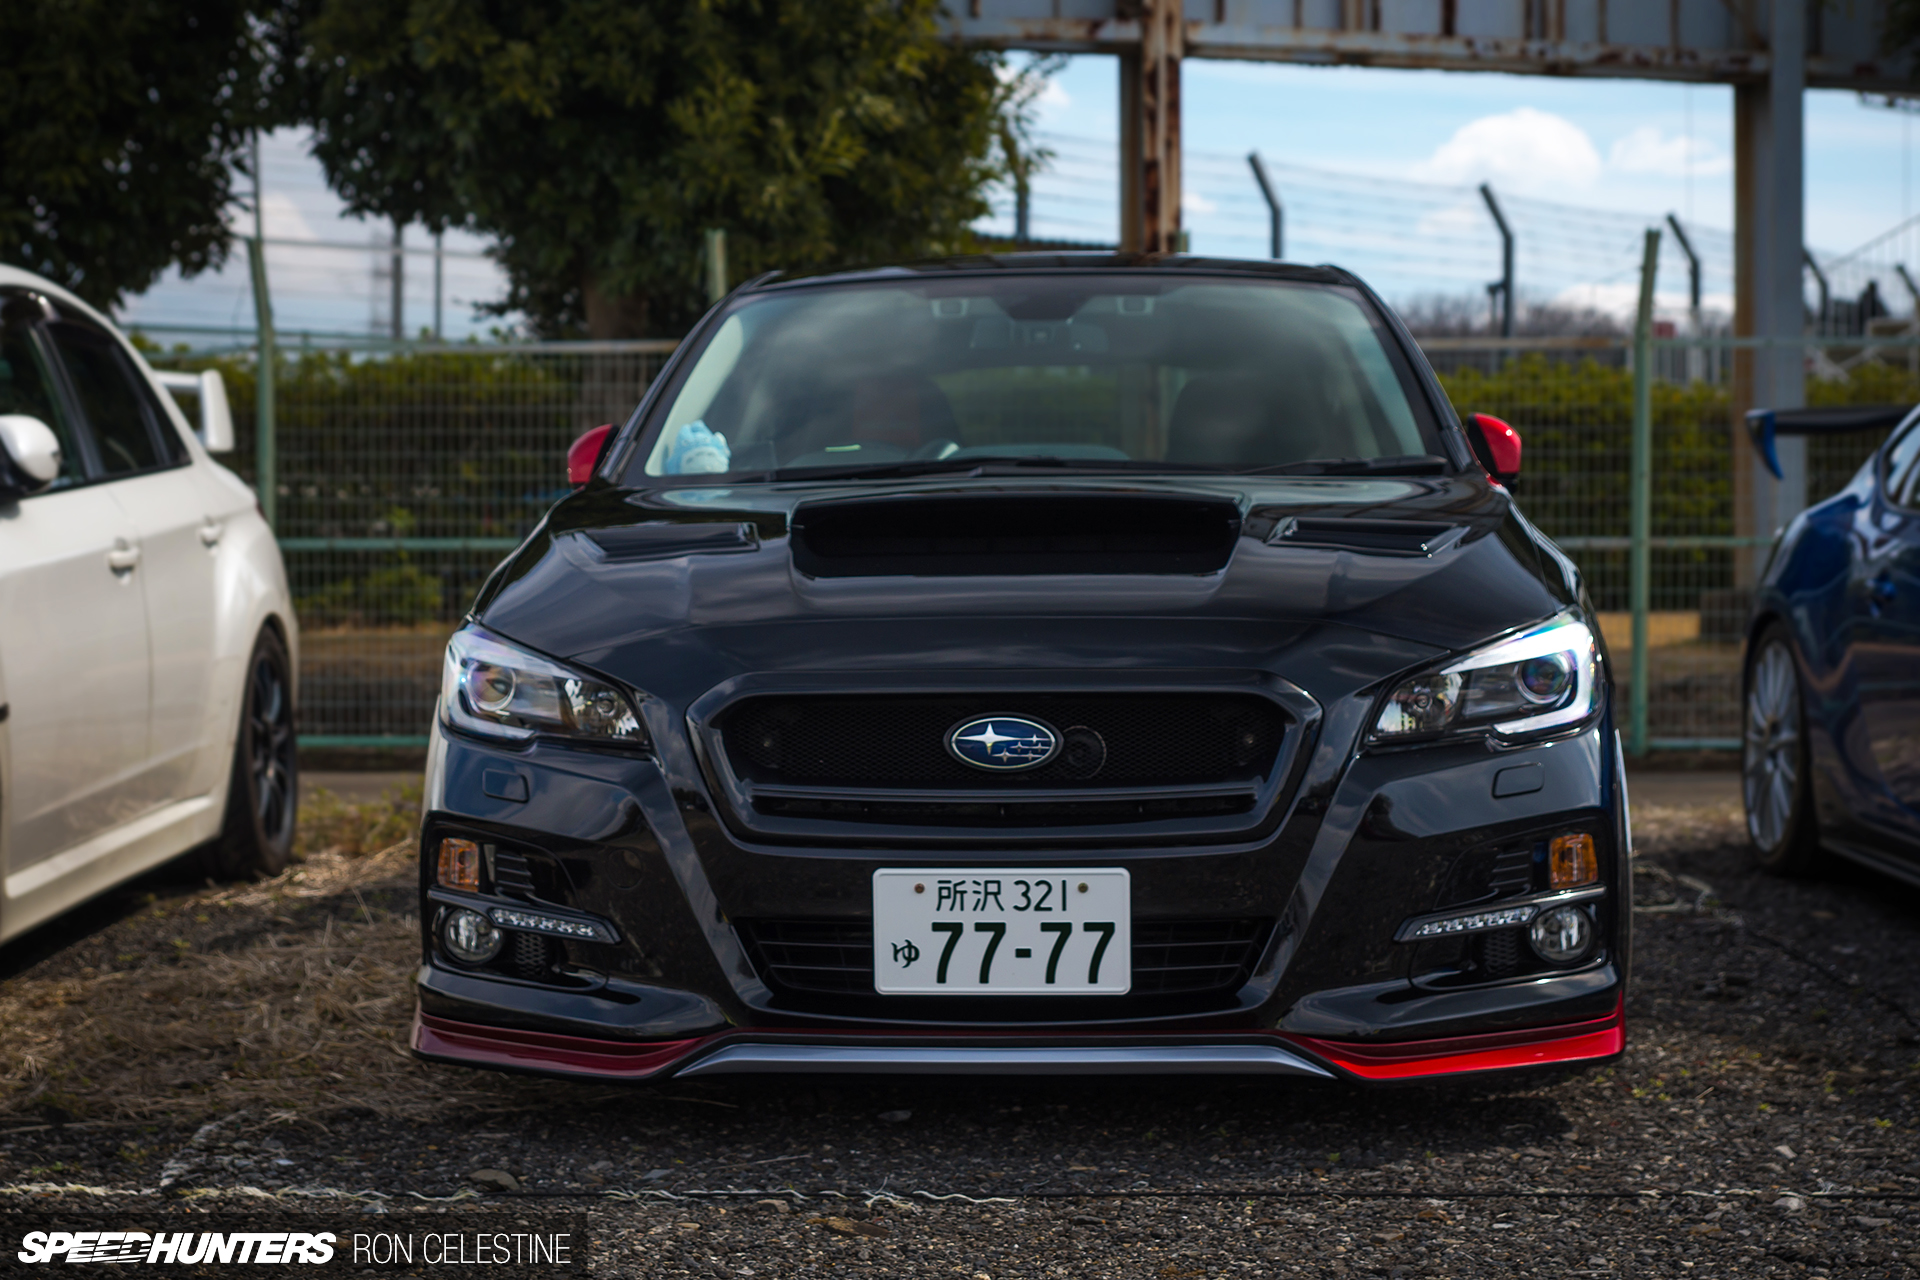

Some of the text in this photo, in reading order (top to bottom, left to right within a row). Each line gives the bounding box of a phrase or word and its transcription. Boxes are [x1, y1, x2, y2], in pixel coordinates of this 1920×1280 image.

[936, 879, 1067, 912] 所沢 321
[890, 921, 1116, 985] ゆ 77-77
